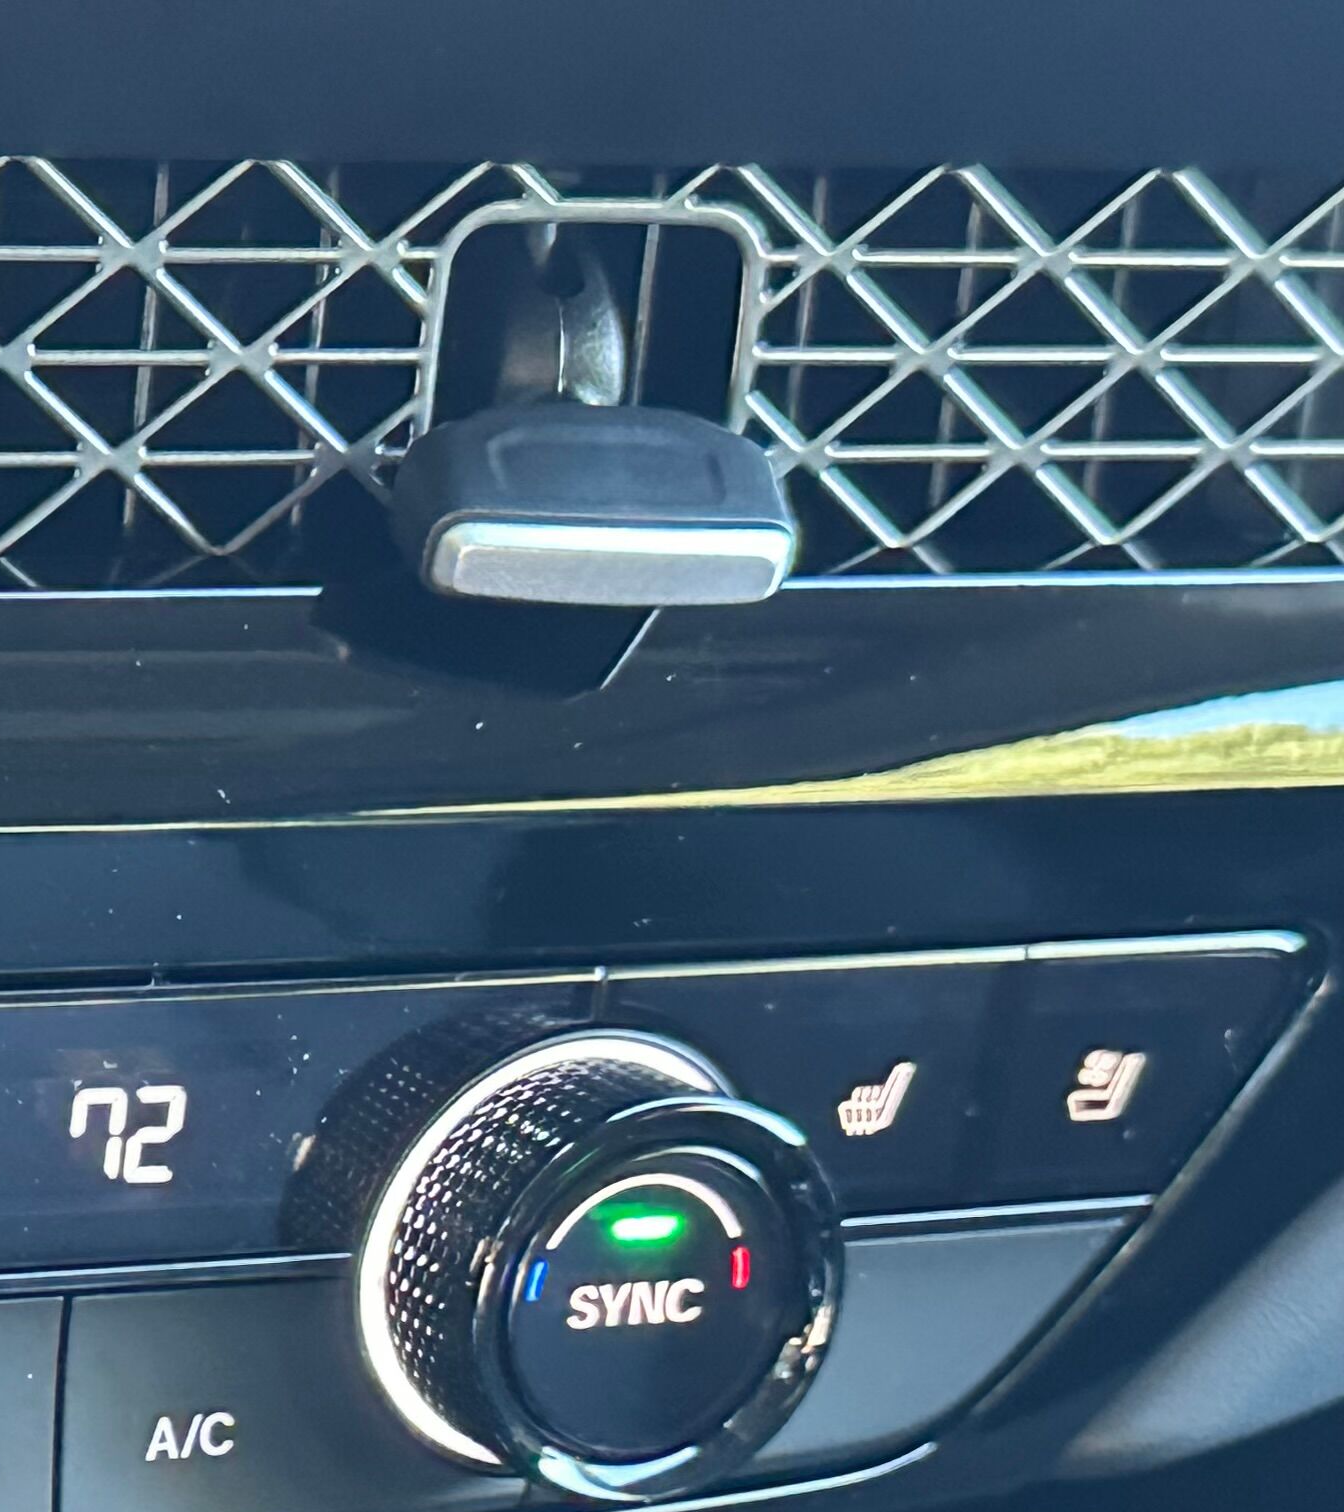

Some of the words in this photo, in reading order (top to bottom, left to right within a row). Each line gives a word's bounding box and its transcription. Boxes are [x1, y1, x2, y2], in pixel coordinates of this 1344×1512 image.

[70, 1084, 189, 1185] 72
[567, 1280, 705, 1330] SYNC
[146, 1412, 236, 1462] A/C
